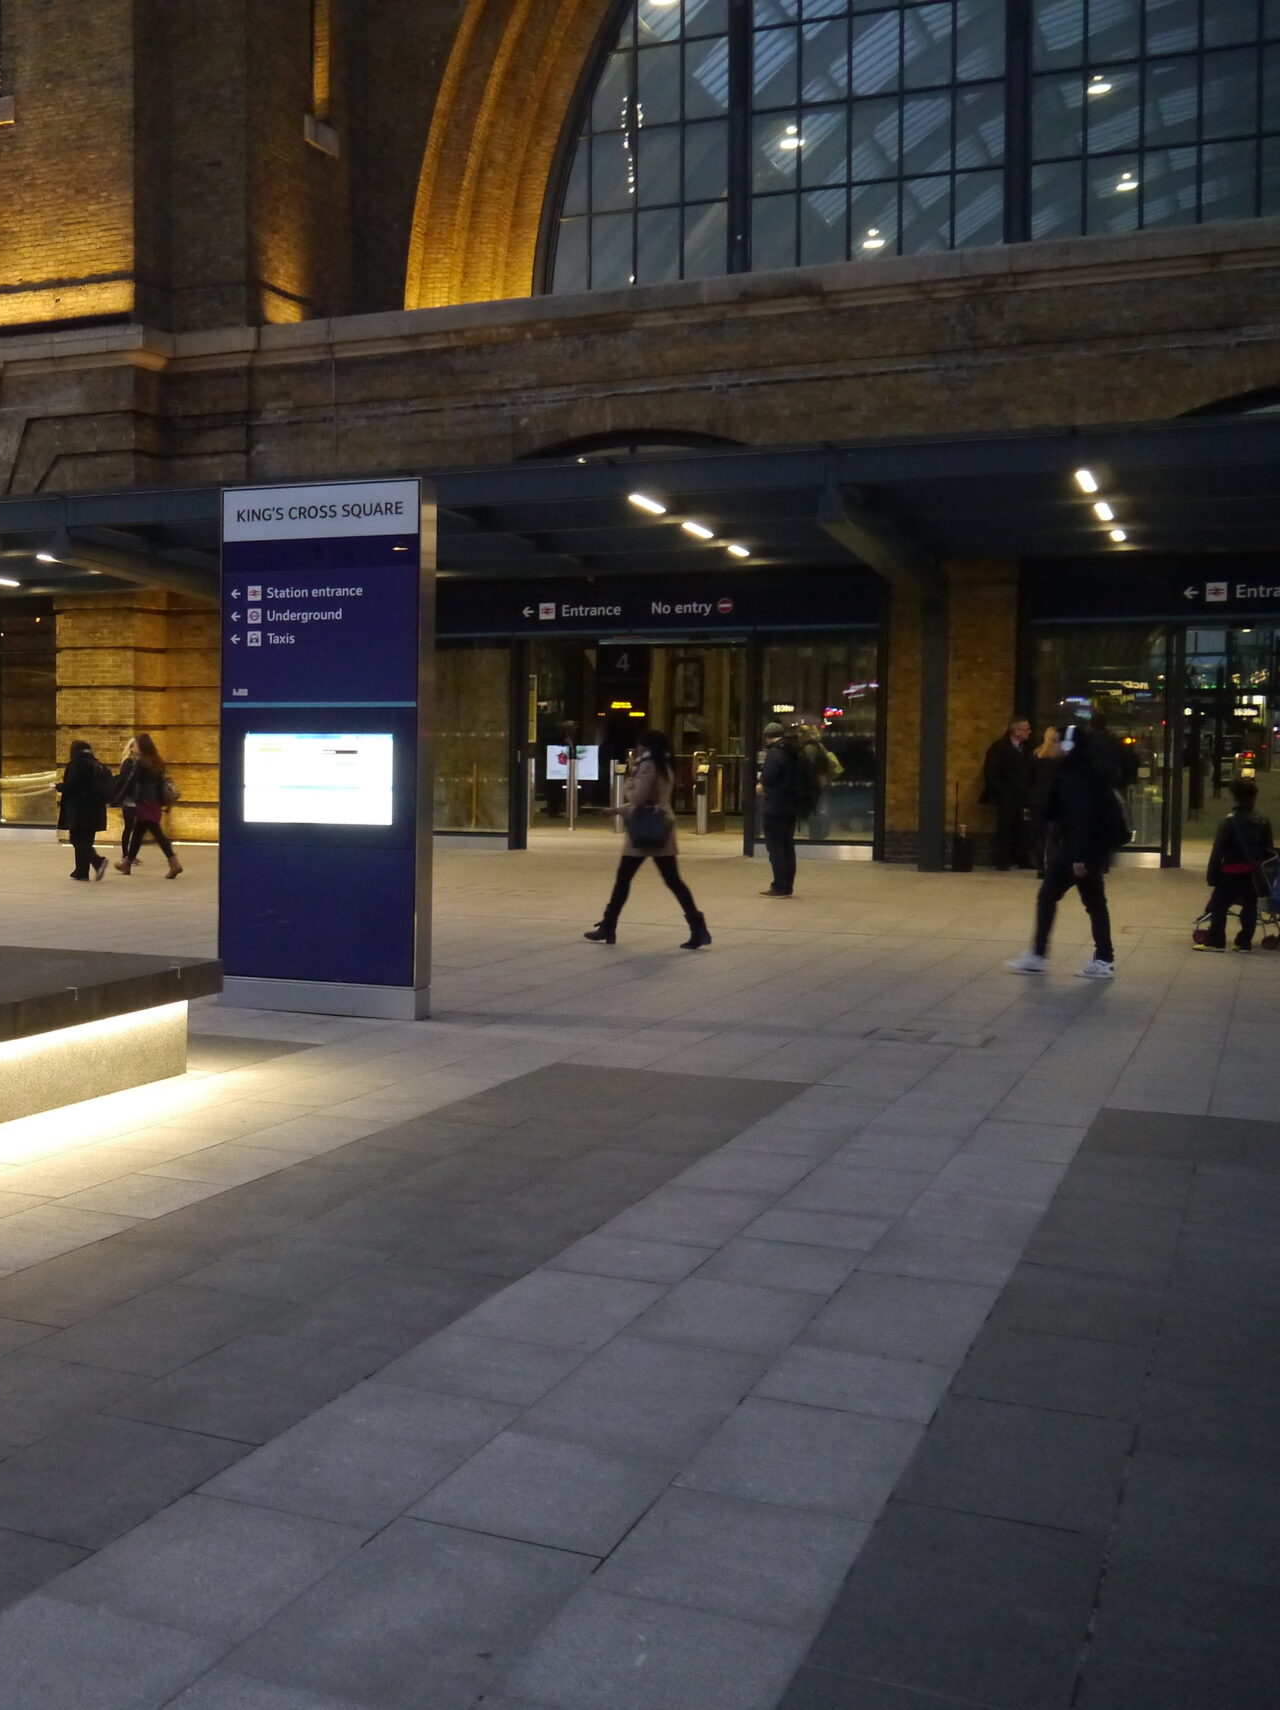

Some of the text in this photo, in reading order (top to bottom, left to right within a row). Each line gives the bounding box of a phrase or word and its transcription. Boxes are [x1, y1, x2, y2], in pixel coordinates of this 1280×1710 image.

[236, 501, 404, 523] KING'S CROSS SQUARE
[266, 586, 363, 599] Station entrance
[561, 604, 622, 617] Entrance
[651, 601, 712, 615] No entry
[266, 608, 343, 623] Underground
[267, 633, 295, 644] Taxis
[616, 653, 630, 671] 4
